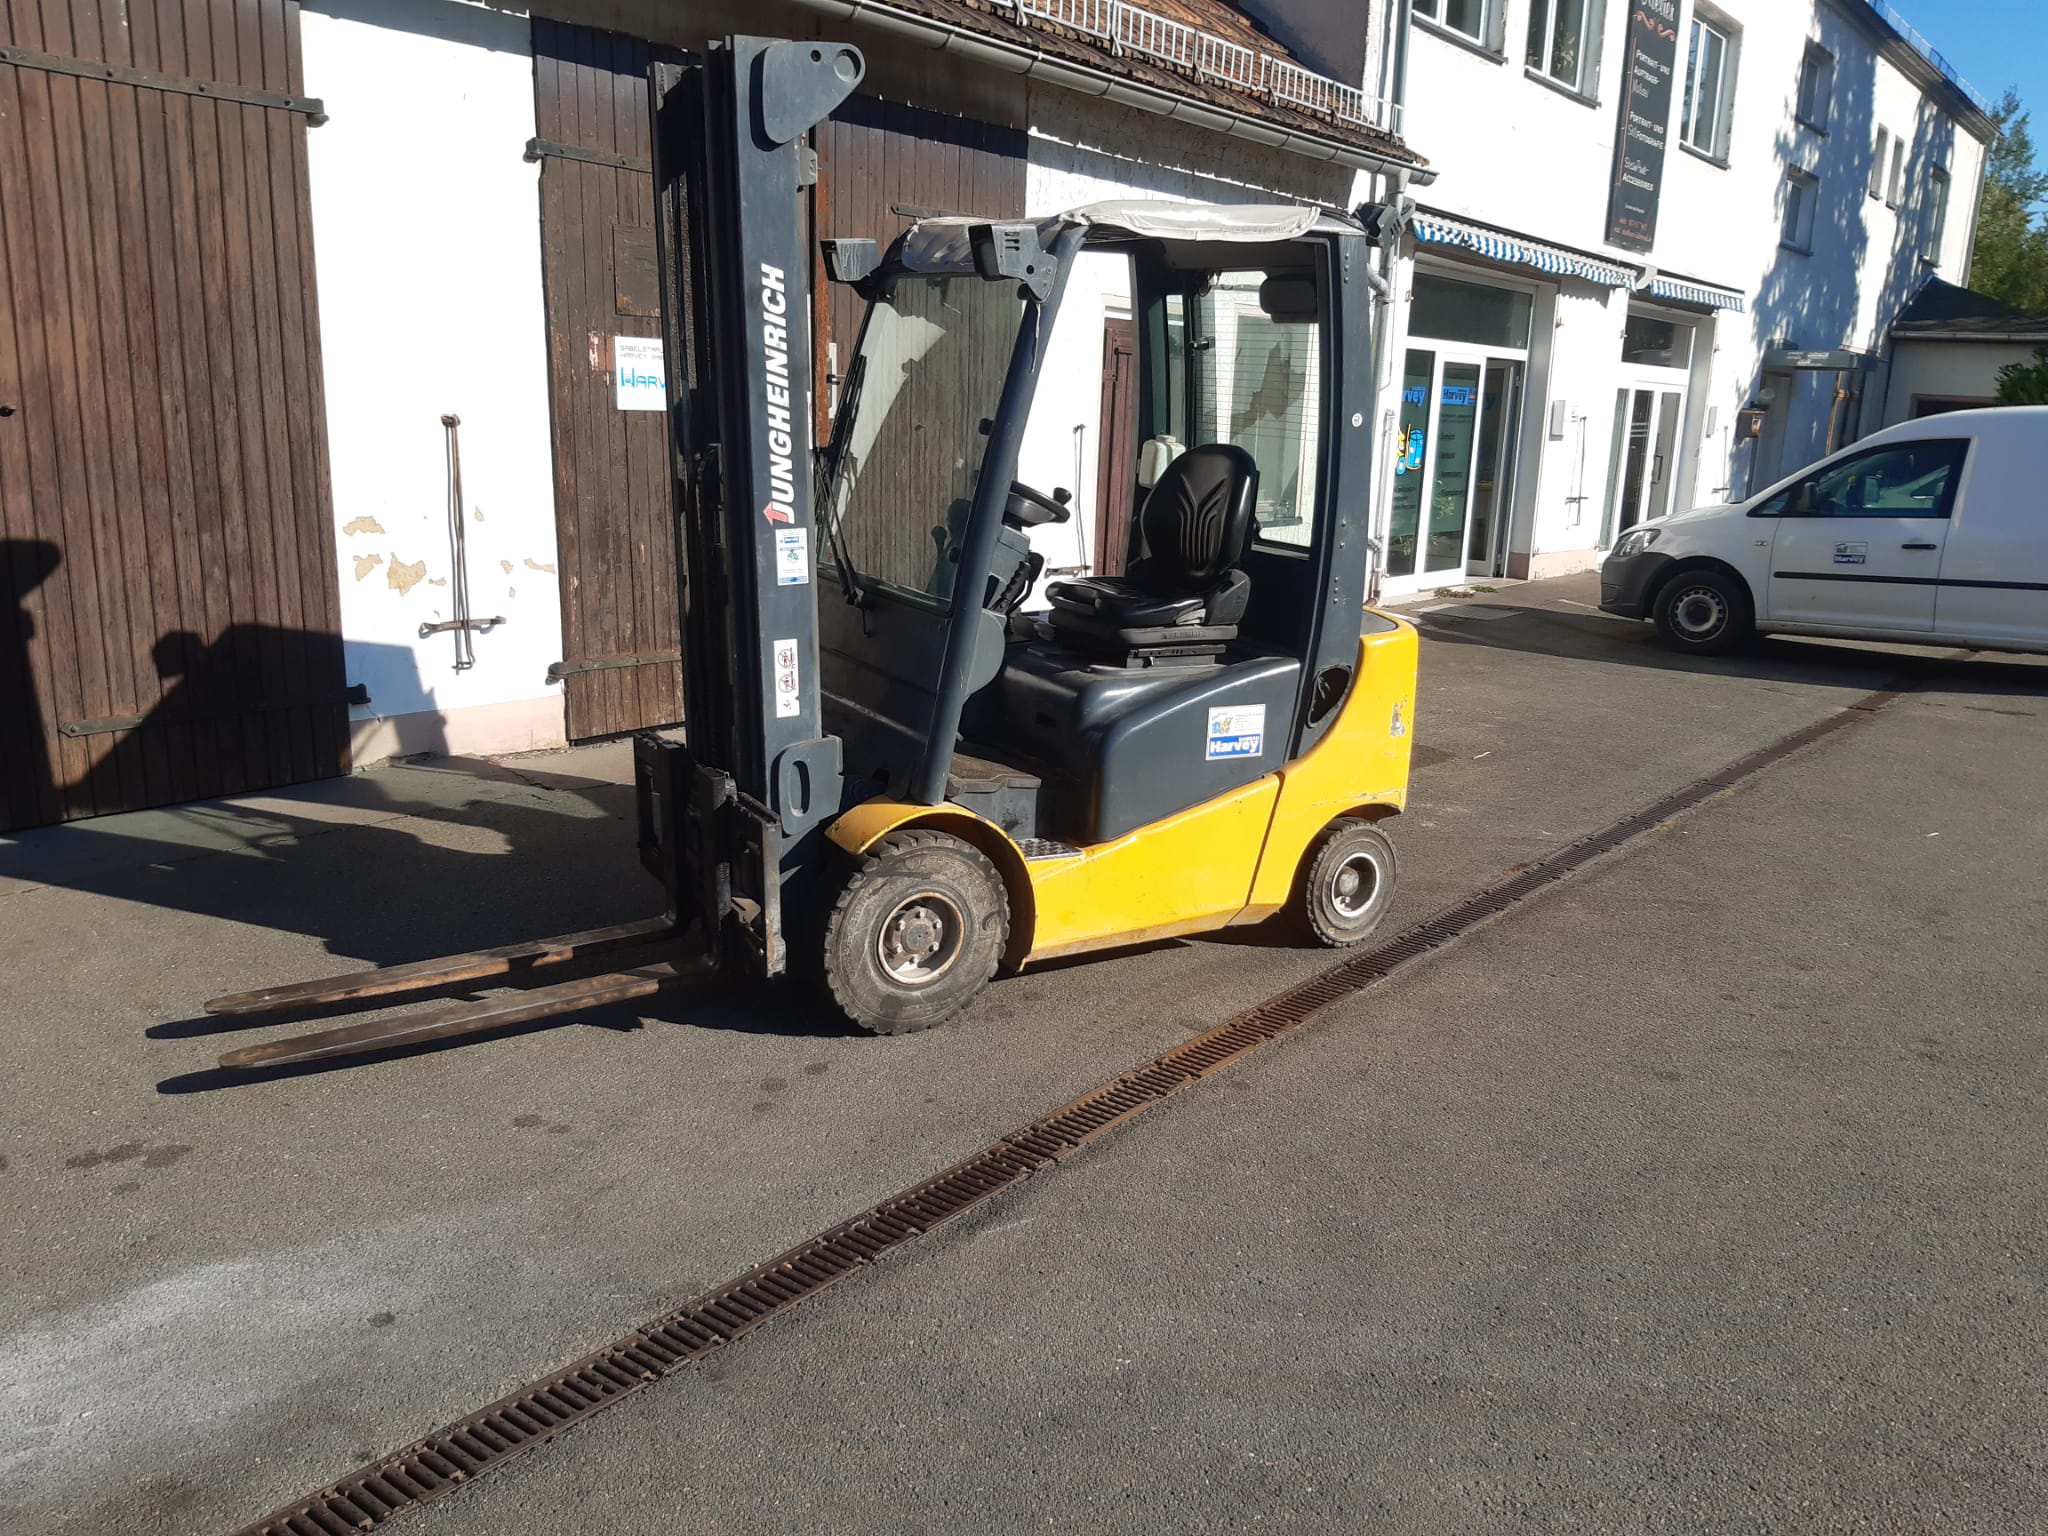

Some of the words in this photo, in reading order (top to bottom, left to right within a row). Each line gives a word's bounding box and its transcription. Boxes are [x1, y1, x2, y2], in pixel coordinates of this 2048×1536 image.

[620, 367, 667, 389] HARV
[761, 262, 795, 526] JUNGHEINRICH
[1402, 389, 1426, 407] rvey
[1211, 740, 1258, 753] Harvey
